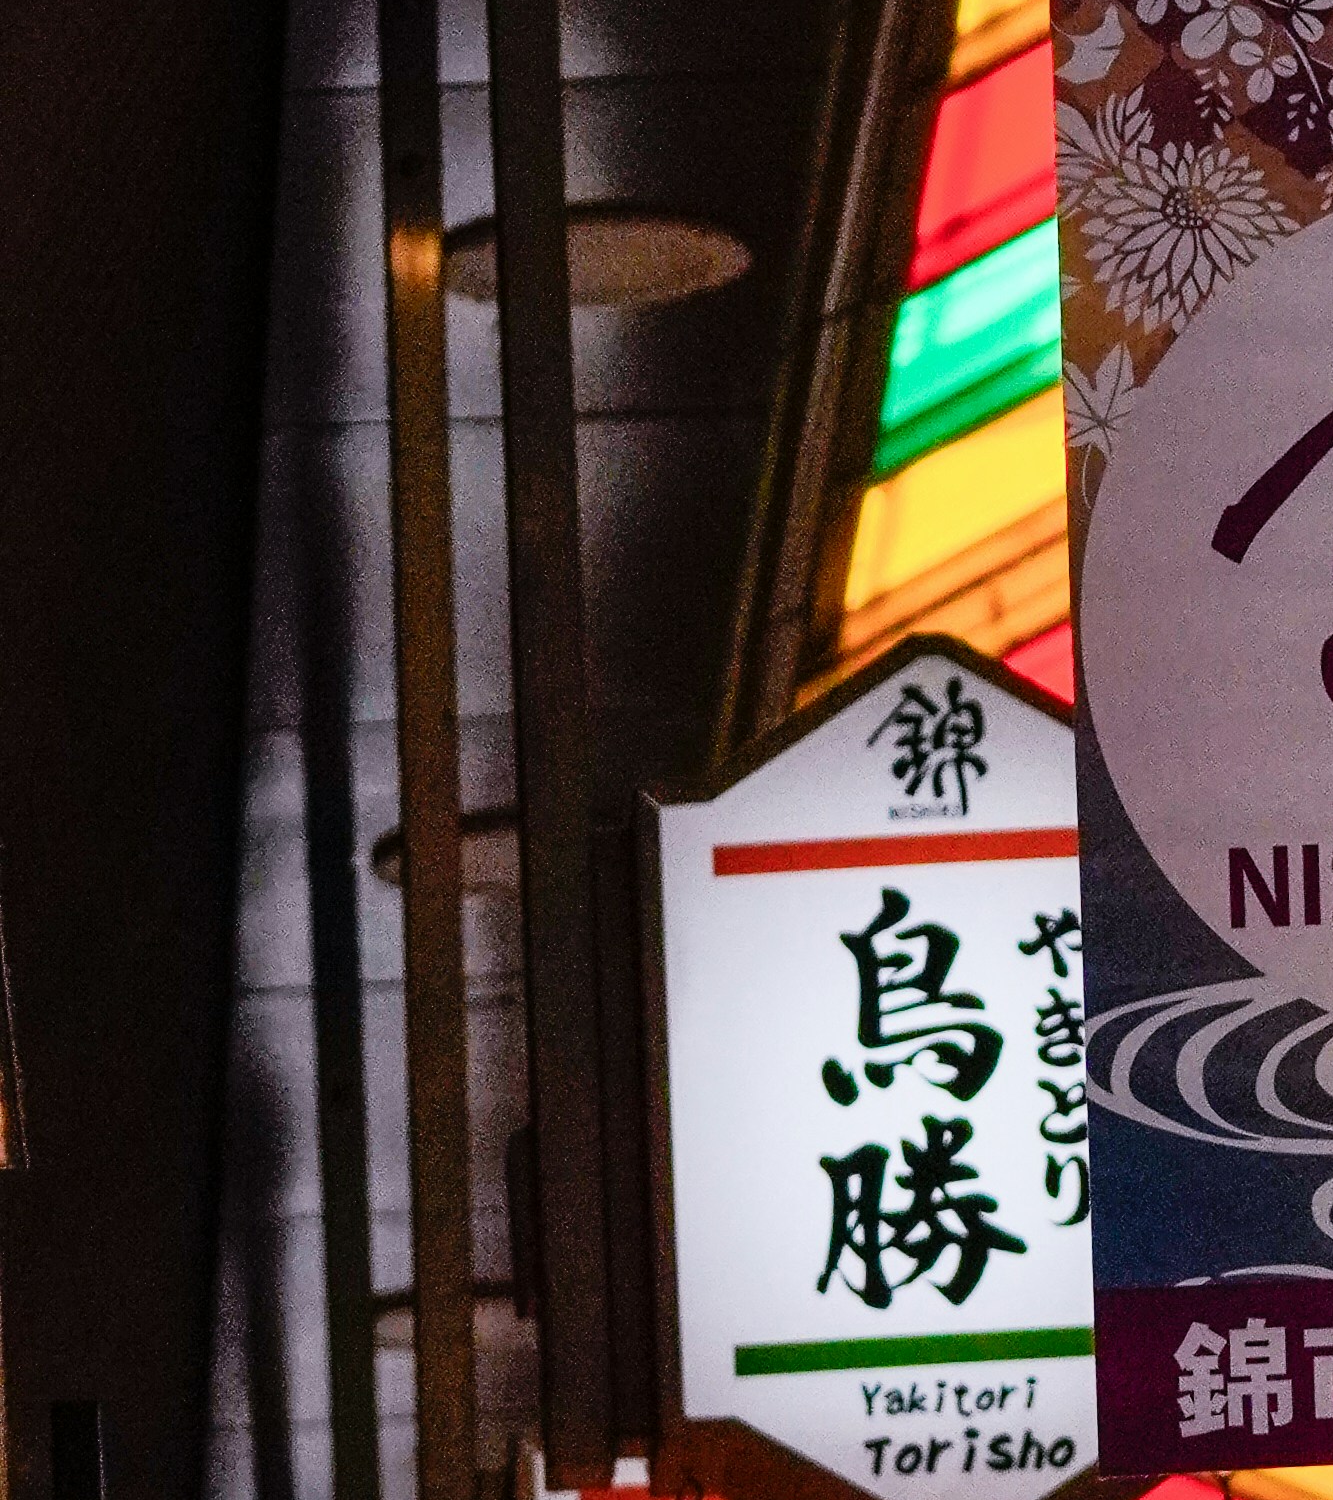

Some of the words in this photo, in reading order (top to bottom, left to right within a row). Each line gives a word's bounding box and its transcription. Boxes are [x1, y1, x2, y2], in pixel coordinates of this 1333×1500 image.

[866, 675, 989, 817] 錦
[816, 886, 1028, 1311] 鳥勝
[1017, 905, 1092, 1228] やきとり
[862, 1375, 1038, 1418] Yakitori
[863, 1426, 1078, 1477] Torisho
